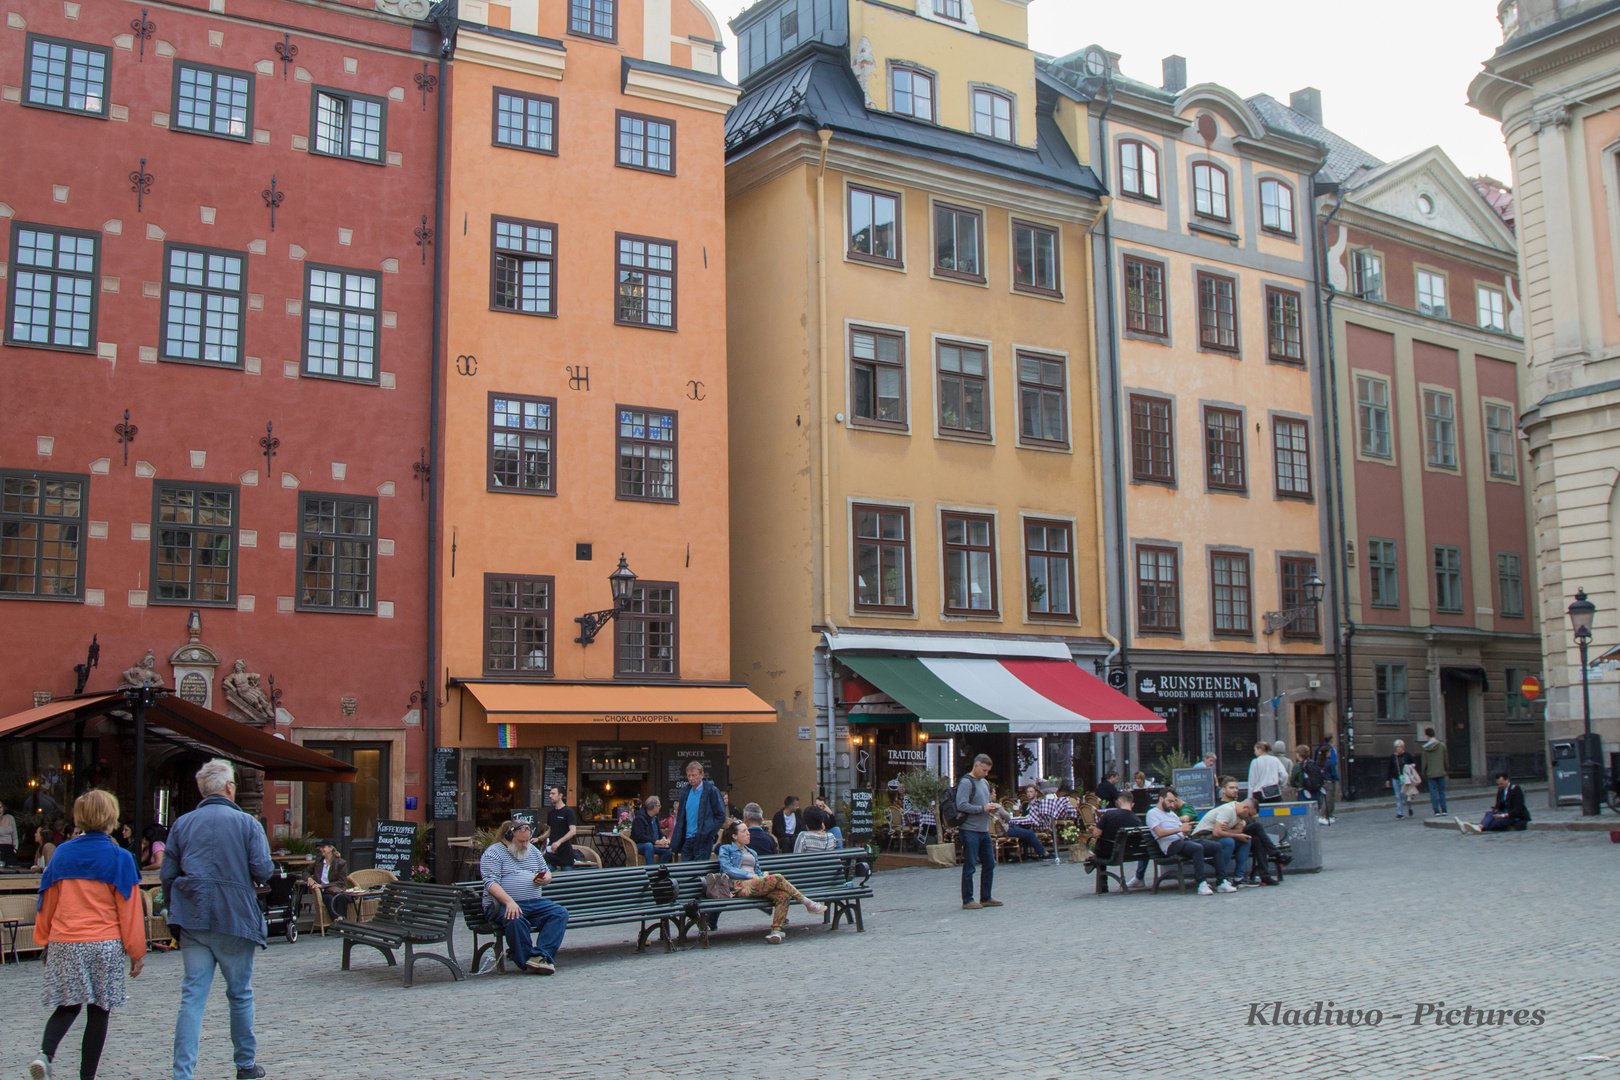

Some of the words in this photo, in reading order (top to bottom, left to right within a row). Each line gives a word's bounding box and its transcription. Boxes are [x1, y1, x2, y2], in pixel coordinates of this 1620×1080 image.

[1160, 676, 1241, 690] RUNSTENEN
[1158, 690, 1189, 698] WOODEN
[1190, 690, 1213, 698] HORSE
[1215, 690, 1243, 699] MUSEUM
[944, 723, 988, 732] TRATTORIA
[1113, 723, 1145, 732] PIZZERIA
